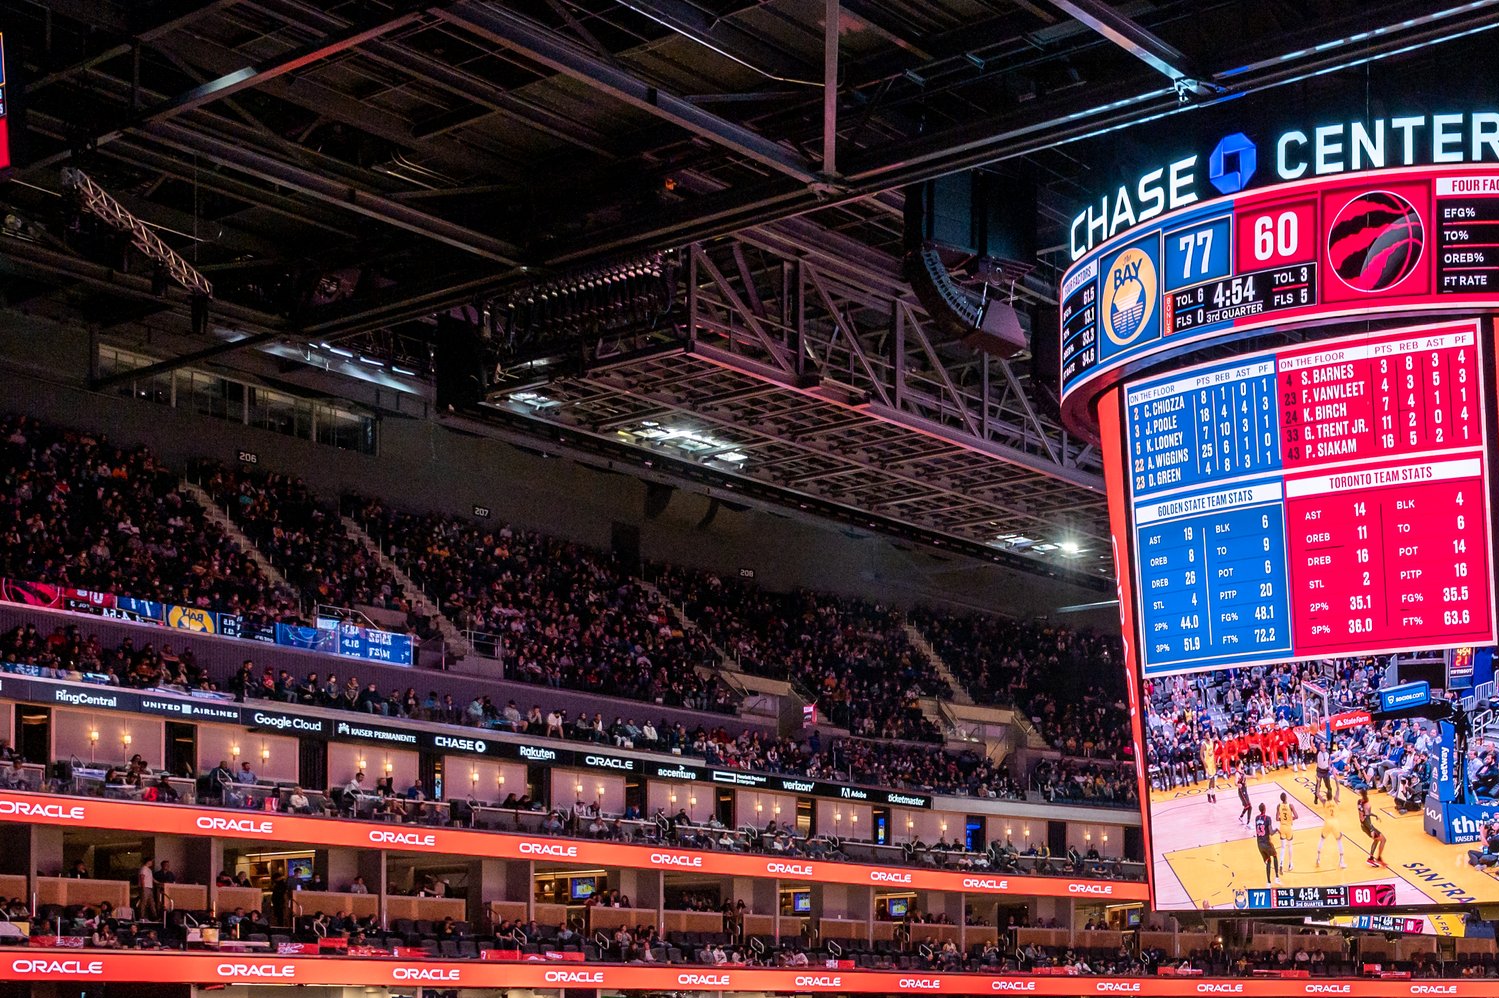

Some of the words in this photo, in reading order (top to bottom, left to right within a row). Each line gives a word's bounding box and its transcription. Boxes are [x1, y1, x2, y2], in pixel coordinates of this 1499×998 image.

[1452, 180, 1479, 192] FOUR
[1070, 155, 1198, 262] CHASE
[1444, 207, 1476, 218] EFG%
[1254, 211, 1298, 261] 60
[1444, 230, 1469, 241] TO%
[1179, 229, 1213, 279] 77
[1444, 253, 1484, 264] OREB%
[1114, 258, 1143, 289] BAY
[1274, 272, 1295, 285] TOL
[1301, 267, 1308, 282] 3
[1444, 277, 1457, 286] FT
[1460, 275, 1487, 286] RATE
[1214, 276, 1255, 308] 4:54
[1274, 294, 1293, 306] FLS
[1301, 289, 1308, 303] 5
[1207, 311, 1219, 323] 3rd
[1222, 303, 1263, 320] QUARTER
[1280, 360, 1293, 370] ON
[1296, 356, 1313, 367] THE
[1314, 352, 1345, 364] FLOOR
[1374, 345, 1393, 355] PTS
[1399, 341, 1419, 352] REB
[1426, 338, 1445, 348] AST
[1454, 335, 1467, 344] PF
[1301, 371, 1311, 386] S.
[1313, 364, 1354, 384] BARNES
[1302, 389, 1311, 404] F.
[1313, 381, 1365, 402] VANVLEET
[1153, 395, 1185, 416] CHIOZZA
[1303, 408, 1313, 422] K.
[1315, 403, 1347, 421] BIRCH
[1154, 415, 1178, 434] POOLE
[1304, 426, 1315, 441] G.
[1316, 420, 1349, 439] TRENT
[1352, 418, 1369, 434] JR.
[1146, 438, 1154, 453] K.
[1154, 432, 1183, 451] LOONEY
[1306, 444, 1315, 459] P.
[1317, 438, 1357, 457] SIAKAM
[1156, 448, 1189, 469] WIGGINS
[1157, 468, 1182, 486] GREEN
[1329, 473, 1372, 490] TORONTO
[1374, 469, 1400, 485] TEAM
[1402, 466, 1433, 482] STATS
[1158, 500, 1184, 517] GOLDEN
[1184, 497, 1206, 512] STATE
[1206, 493, 1227, 508] TEAM
[1228, 489, 1253, 505] STATS
[55, 690, 117, 707] RingCentral
[143, 700, 181, 711] UNITED
[193, 707, 239, 719] AIRLINES
[254, 713, 291, 728] Google
[292, 718, 322, 731] Cloud
[351, 728, 374, 738] KAISER
[374, 730, 417, 743] PERMANENTE
[435, 736, 475, 751] CHASE
[520, 745, 556, 760] Rakuten
[585, 755, 633, 770] ORACLE
[1441, 746, 1449, 782] betway
[658, 767, 696, 780] accenture
[851, 790, 867, 799] Adobe
[888, 794, 925, 806] ticketmaster
[0, 800, 85, 820] ORACLE
[196, 816, 273, 834] ORACLE
[368, 830, 436, 847] ORACLE
[518, 842, 578, 857] ORACLE
[650, 853, 702, 867] ORACLE
[766, 862, 813, 876] ORACLE
[870, 871, 912, 883] ORACLE
[963, 878, 1008, 890] ORACLE
[1068, 883, 1113, 895] ORACLE
[1253, 892, 1266, 906] 77
[1299, 888, 1320, 901] 4:54
[1355, 889, 1371, 903] 60
[12, 959, 103, 974] ORACLE
[216, 963, 295, 977] ORACLE
[392, 967, 460, 981] ORACLE
[544, 971, 604, 983] ORACLE
[677, 974, 730, 986] ORACLE
[794, 976, 841, 987] ORACLE
[899, 978, 940, 989] ORACLE
[991, 981, 1036, 991] ORACLE
[1096, 982, 1141, 992] ORACLE
[1196, 983, 1243, 993] ORACLE
[1305, 984, 1351, 993] ORACLE
[1410, 985, 1457, 994] ORACLE
